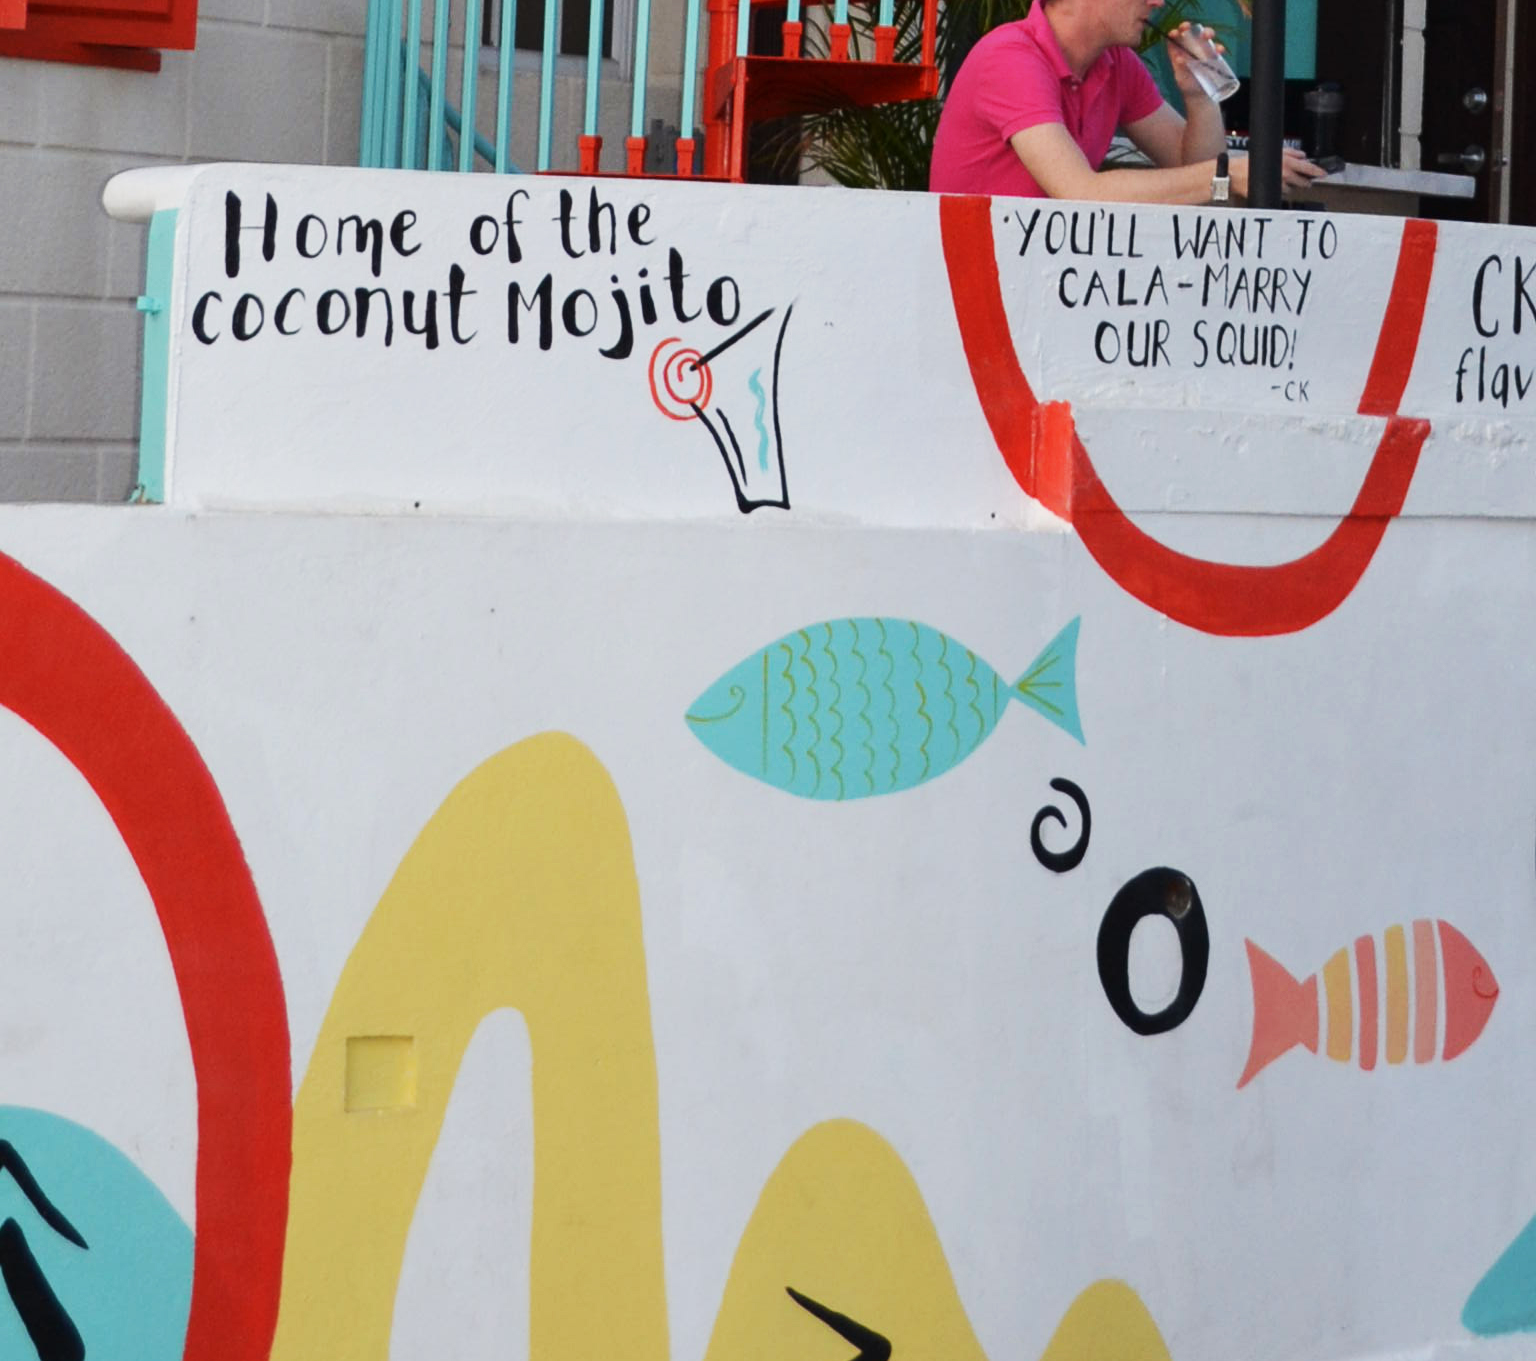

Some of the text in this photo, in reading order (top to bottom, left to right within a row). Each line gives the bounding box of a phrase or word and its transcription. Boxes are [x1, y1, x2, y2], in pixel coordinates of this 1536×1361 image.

[224, 185, 656, 278] Home of the
[1172, 213, 1273, 260] WANT
[1296, 218, 1338, 260] TO
[191, 247, 742, 360] coconut Mojito
[1058, 263, 1313, 316] CALA-MARRY
[1094, 319, 1298, 371] OUR SQUID!
